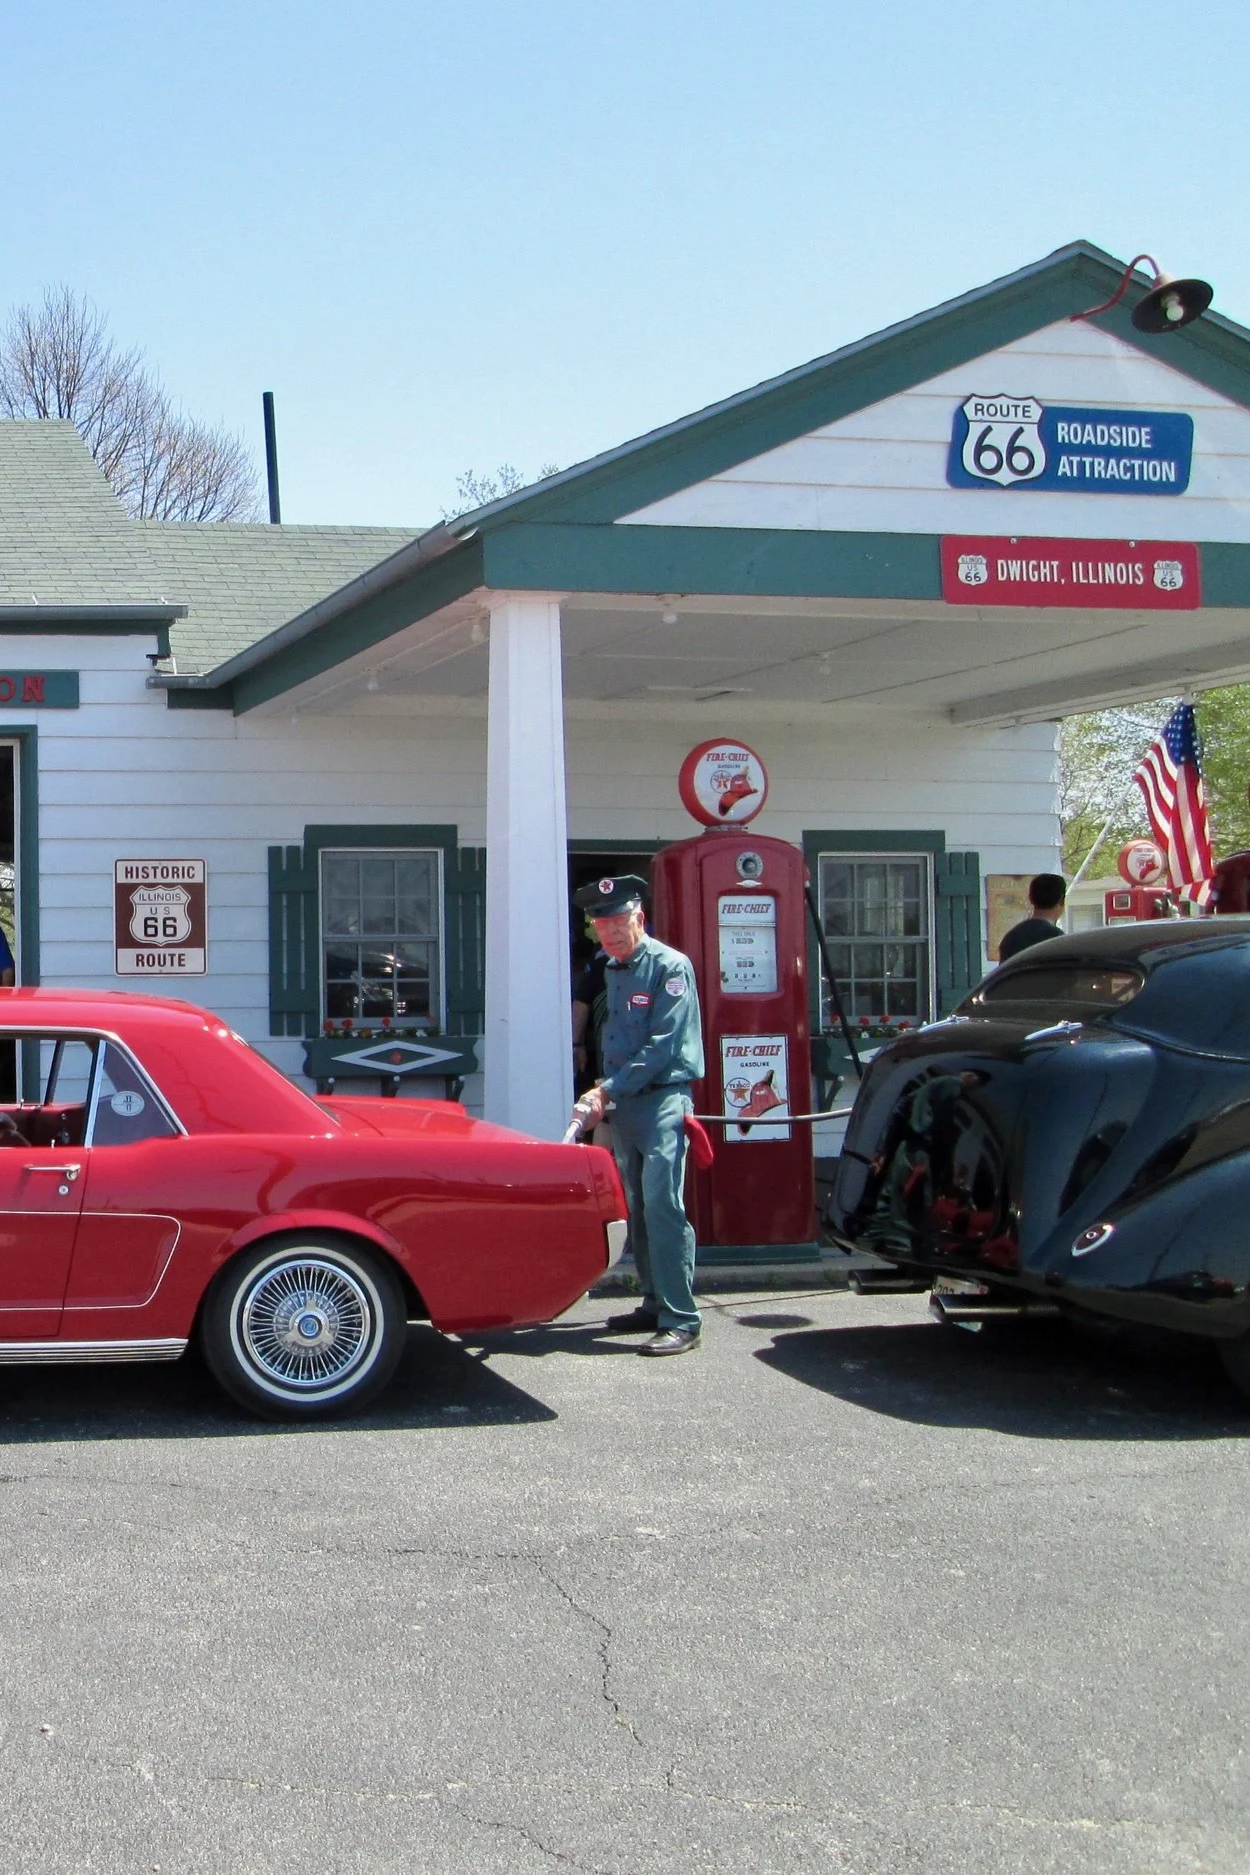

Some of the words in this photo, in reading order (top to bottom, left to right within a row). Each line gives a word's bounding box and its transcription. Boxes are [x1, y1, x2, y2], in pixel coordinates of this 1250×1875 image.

[974, 403, 1032, 419] ROUTE
[1056, 423, 1152, 448] ROADSIDE
[973, 425, 1035, 477] 66
[1057, 455, 1176, 482] ATTRACTION
[965, 572, 981, 582] 66
[997, 559, 1065, 585] DWIGHT,
[1071, 563, 1144, 585] ILLINOIS
[1160, 577, 1177, 587] 66
[124, 866, 196, 880] HISTORIC
[139, 893, 181, 902] ILLINOIS
[721, 903, 772, 914] FIRE-CHIEF
[143, 916, 178, 938] 66
[135, 953, 186, 967] ROUTE
[725, 1045, 783, 1057] FIRE-CHIEF
